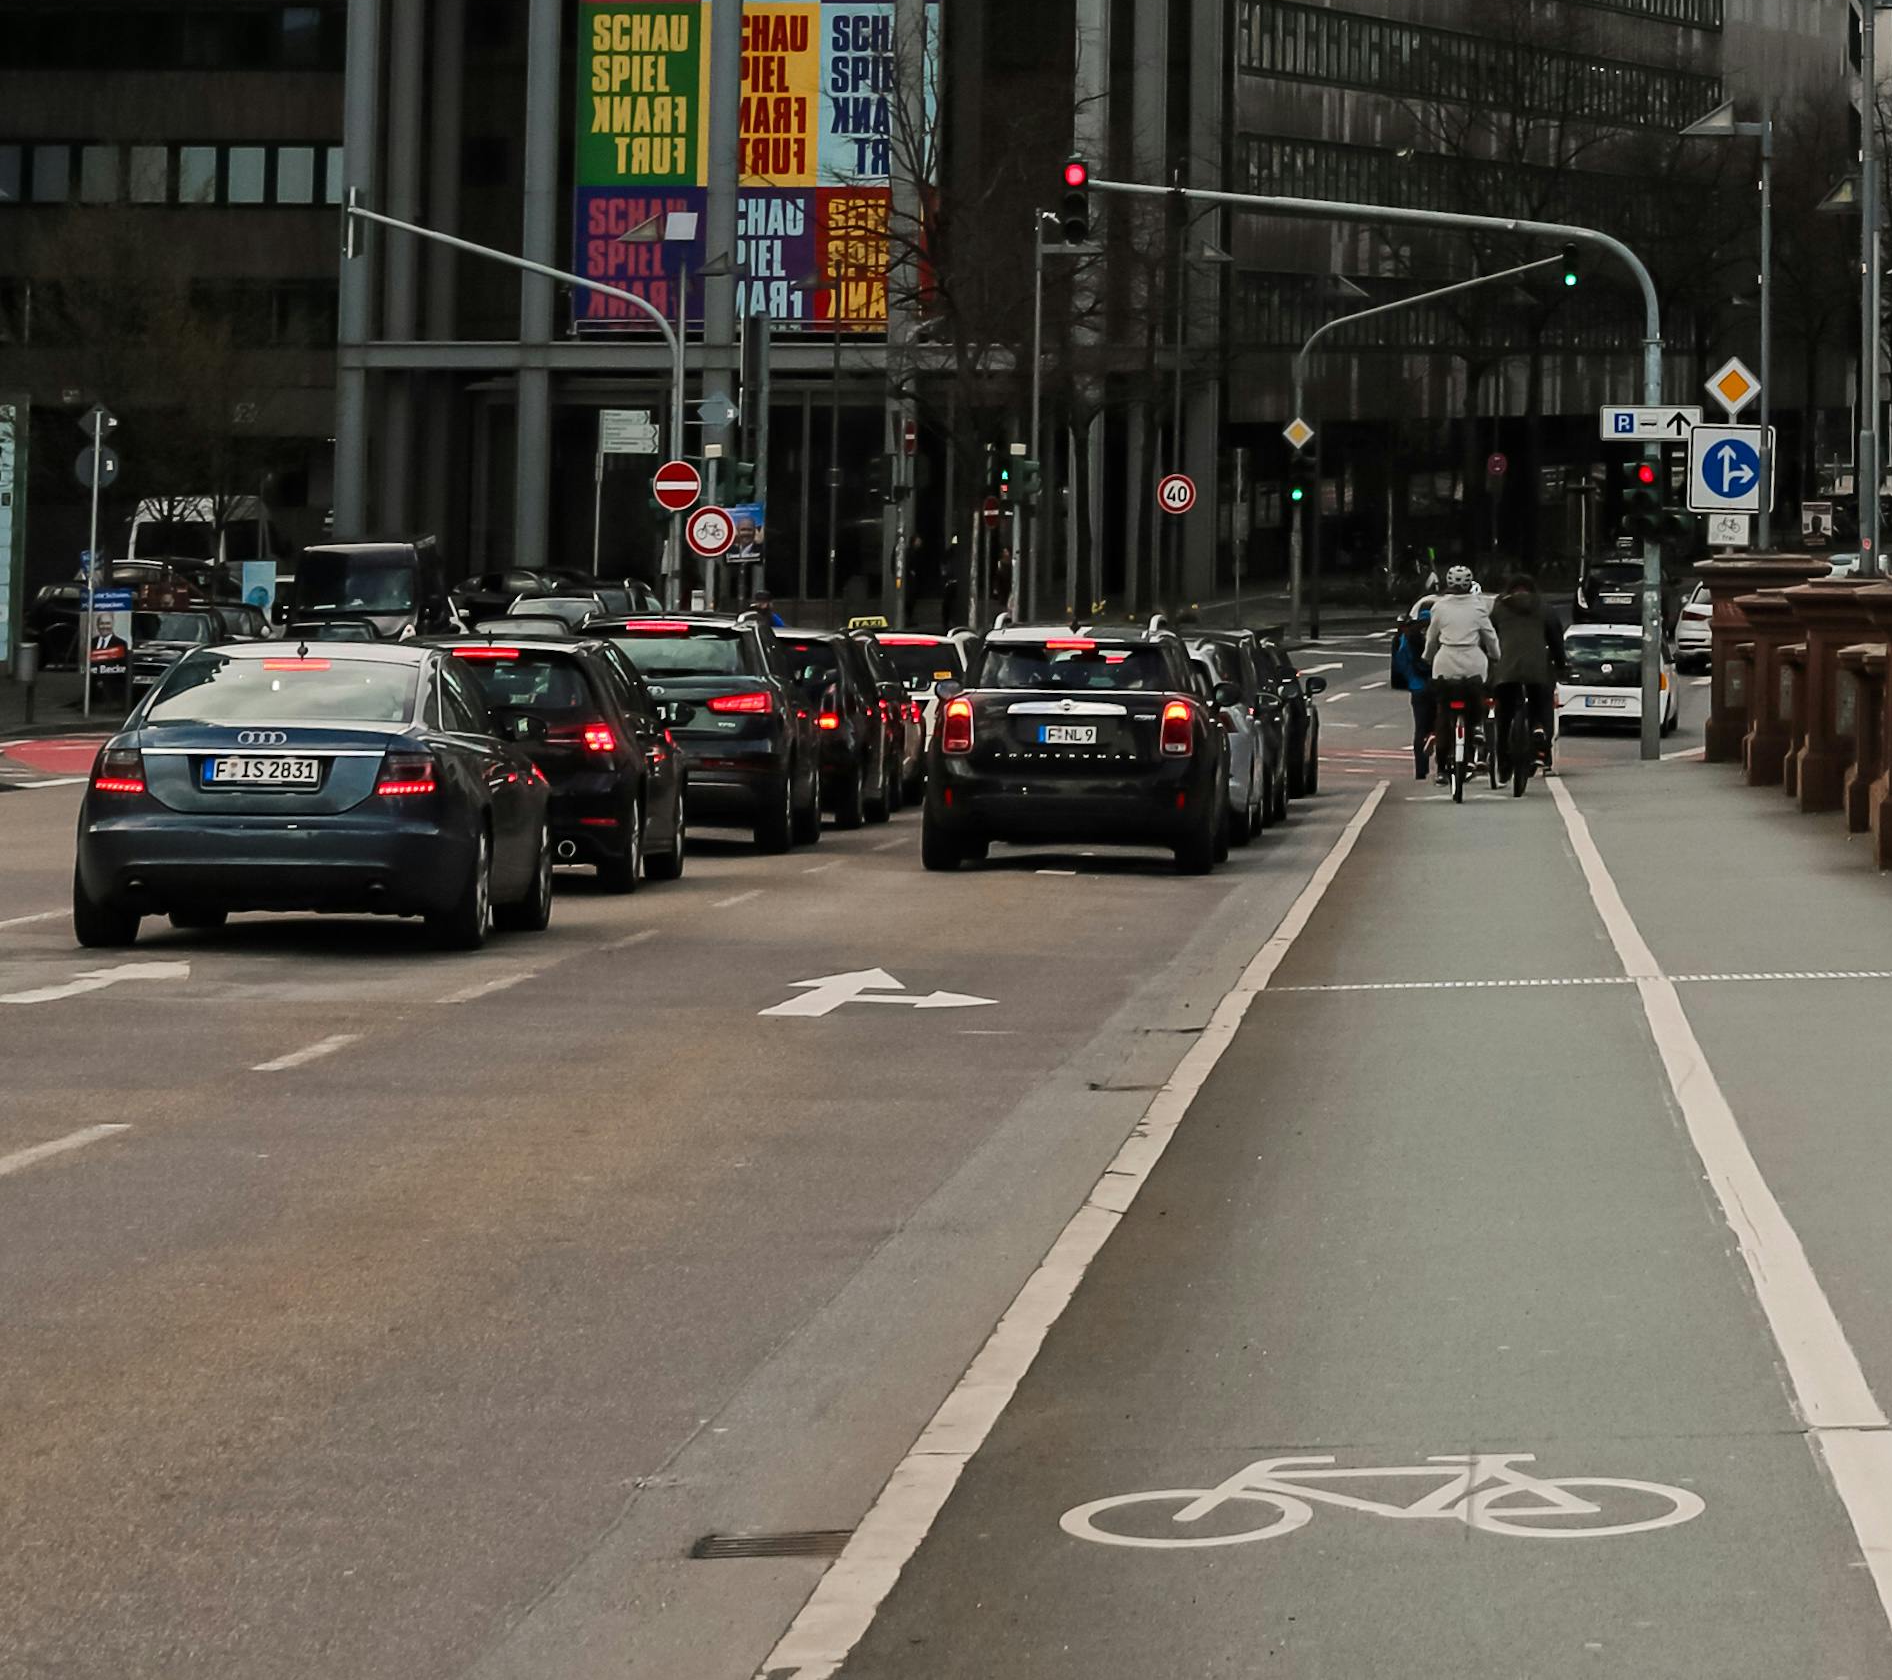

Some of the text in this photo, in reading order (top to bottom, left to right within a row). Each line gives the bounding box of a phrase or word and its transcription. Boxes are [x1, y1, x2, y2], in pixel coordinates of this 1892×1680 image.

[592, 14, 689, 52] SCHAU
[591, 55, 670, 92] SPIEL
[1166, 485, 1188, 502] 40
[1047, 729, 1094, 742] F NL 9
[215, 761, 315, 779] F IS 2831
